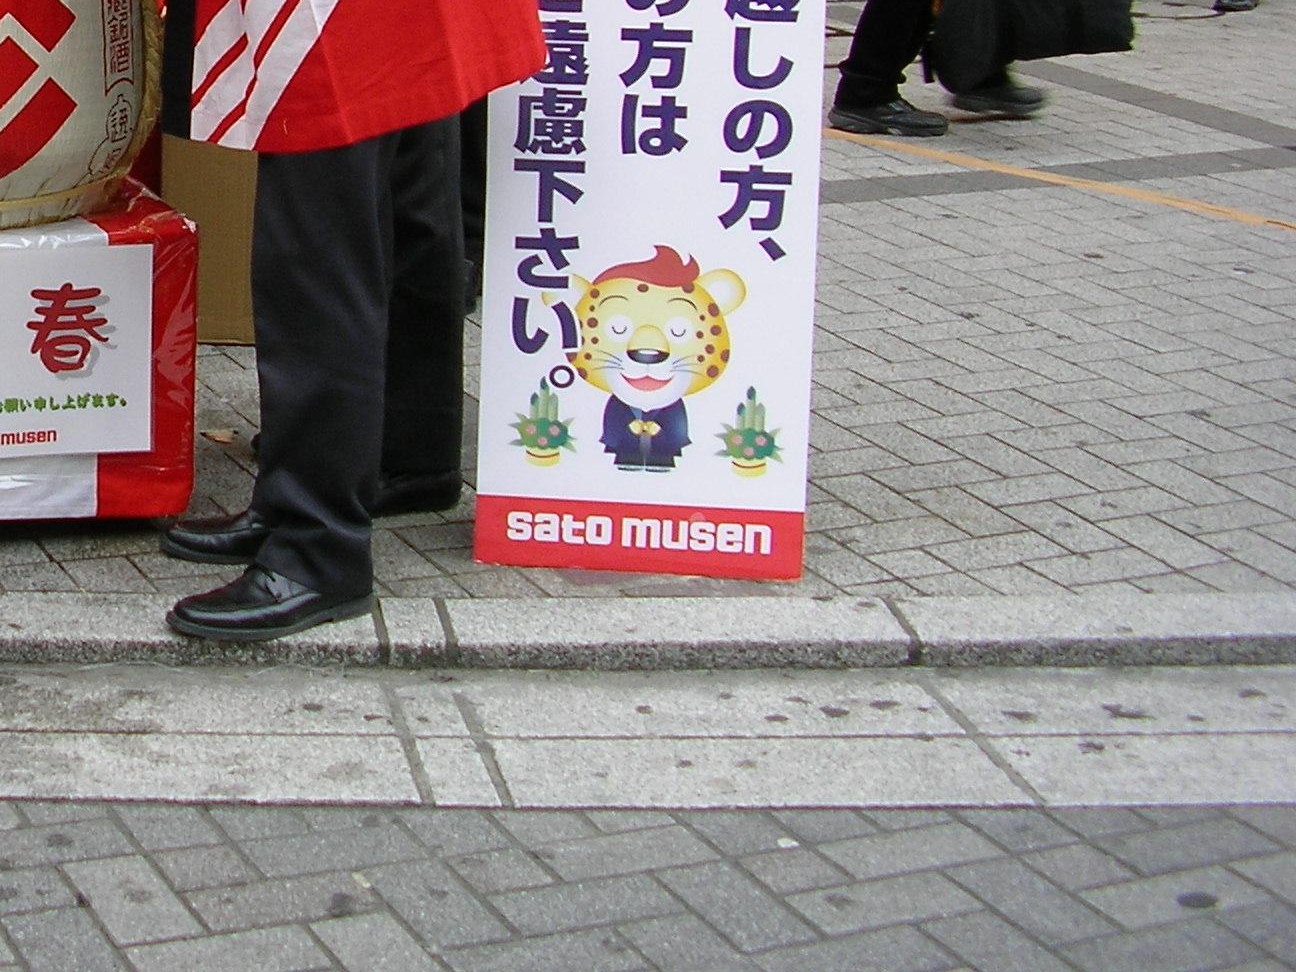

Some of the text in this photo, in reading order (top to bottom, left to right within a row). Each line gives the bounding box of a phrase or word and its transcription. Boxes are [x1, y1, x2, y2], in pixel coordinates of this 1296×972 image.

[1, 429, 57, 445] musen
[506, 511, 772, 556] sato musen
